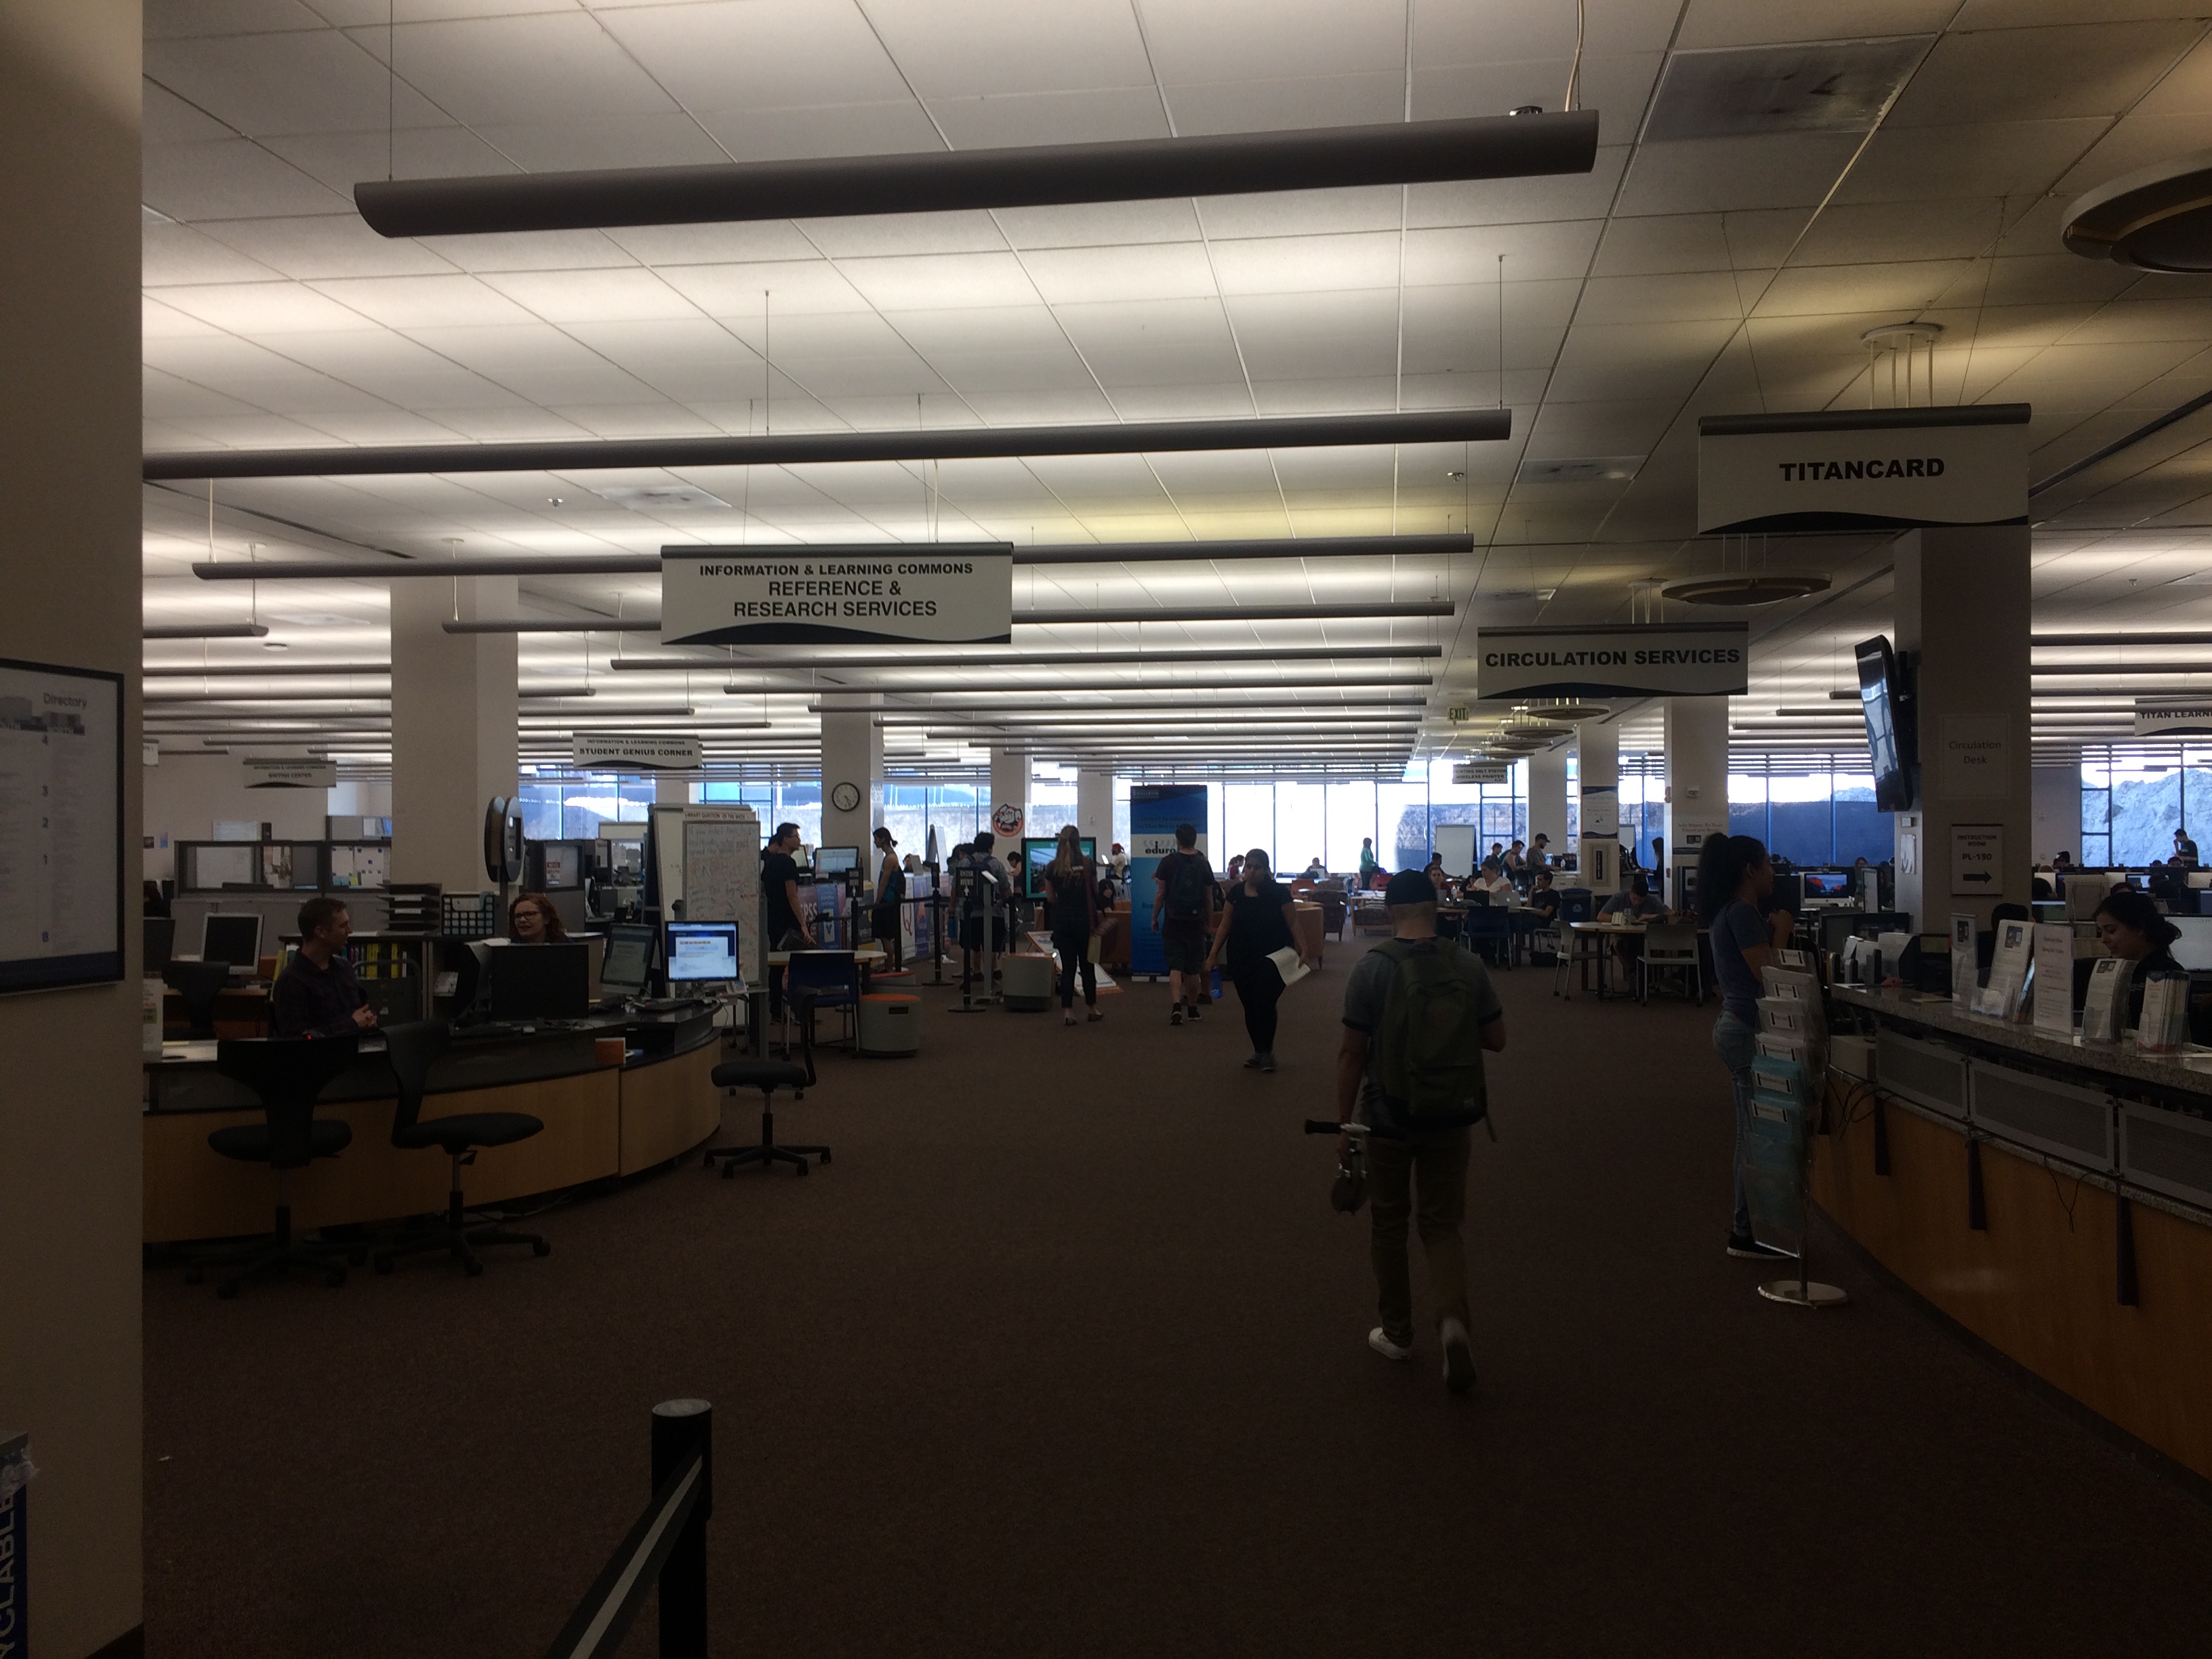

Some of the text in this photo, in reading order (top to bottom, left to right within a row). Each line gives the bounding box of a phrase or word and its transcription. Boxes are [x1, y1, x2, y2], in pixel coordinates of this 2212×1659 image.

[1779, 458, 1944, 481] TITANCARD
[699, 563, 973, 576] INFORMATION & LEARNING COMMONS
[769, 581, 902, 596] REFERENCE &
[734, 600, 937, 617] RESEARCH SERVICES
[1485, 649, 1740, 668] CIRCULATION SERVICES
[43, 693, 87, 709] Directory
[1449, 708, 1467, 720] EXIT
[579, 747, 620, 756] STUDENT
[1949, 741, 2001, 750] Circulation
[1963, 756, 1987, 764] Desk
[1145, 841, 1176, 854] eduro
